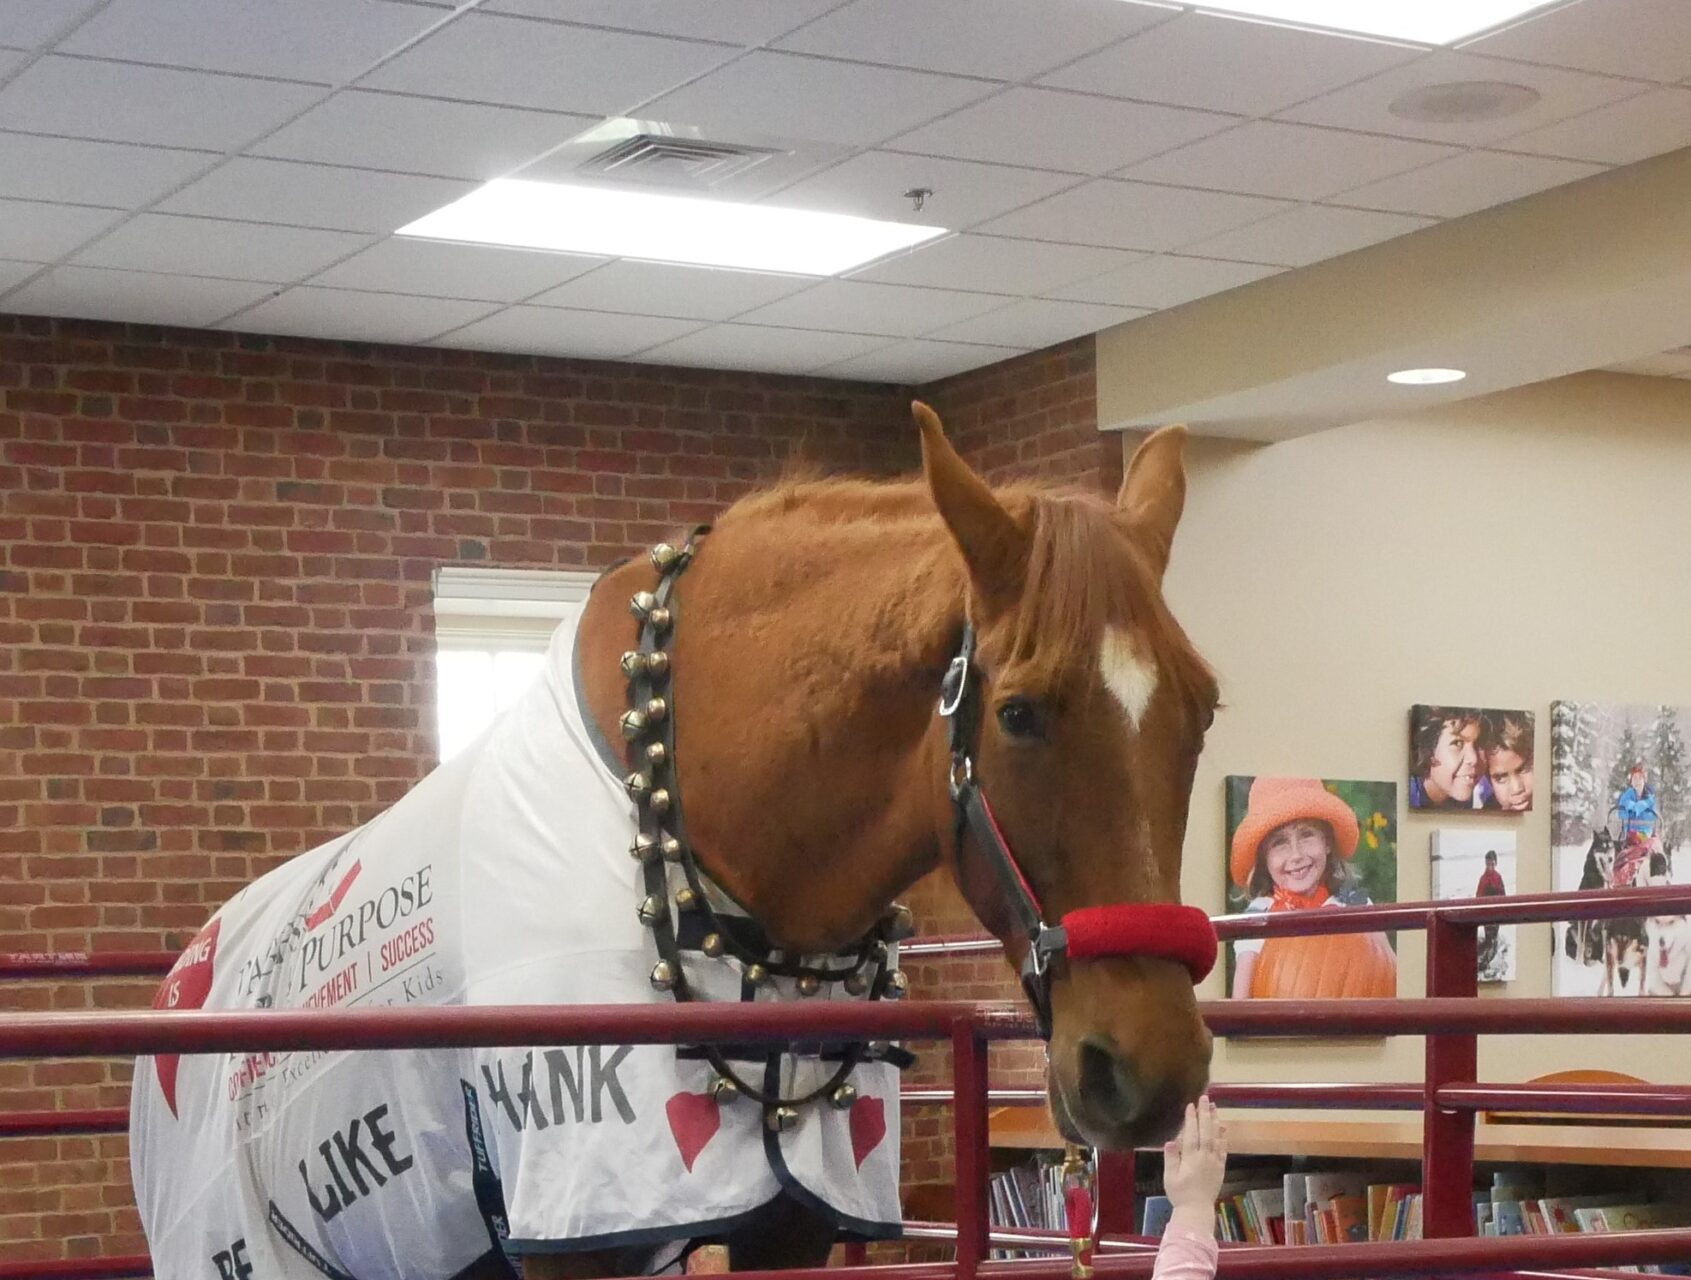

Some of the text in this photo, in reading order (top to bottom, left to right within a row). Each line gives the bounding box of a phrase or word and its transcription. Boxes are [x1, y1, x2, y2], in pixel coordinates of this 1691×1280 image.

[300, 864, 433, 992] PURPOSE
[380, 917, 434, 972] SUCCESS
[402, 966, 443, 1002] Kids
[481, 1046, 637, 1132] HANK
[299, 1103, 413, 1222] LIKE
